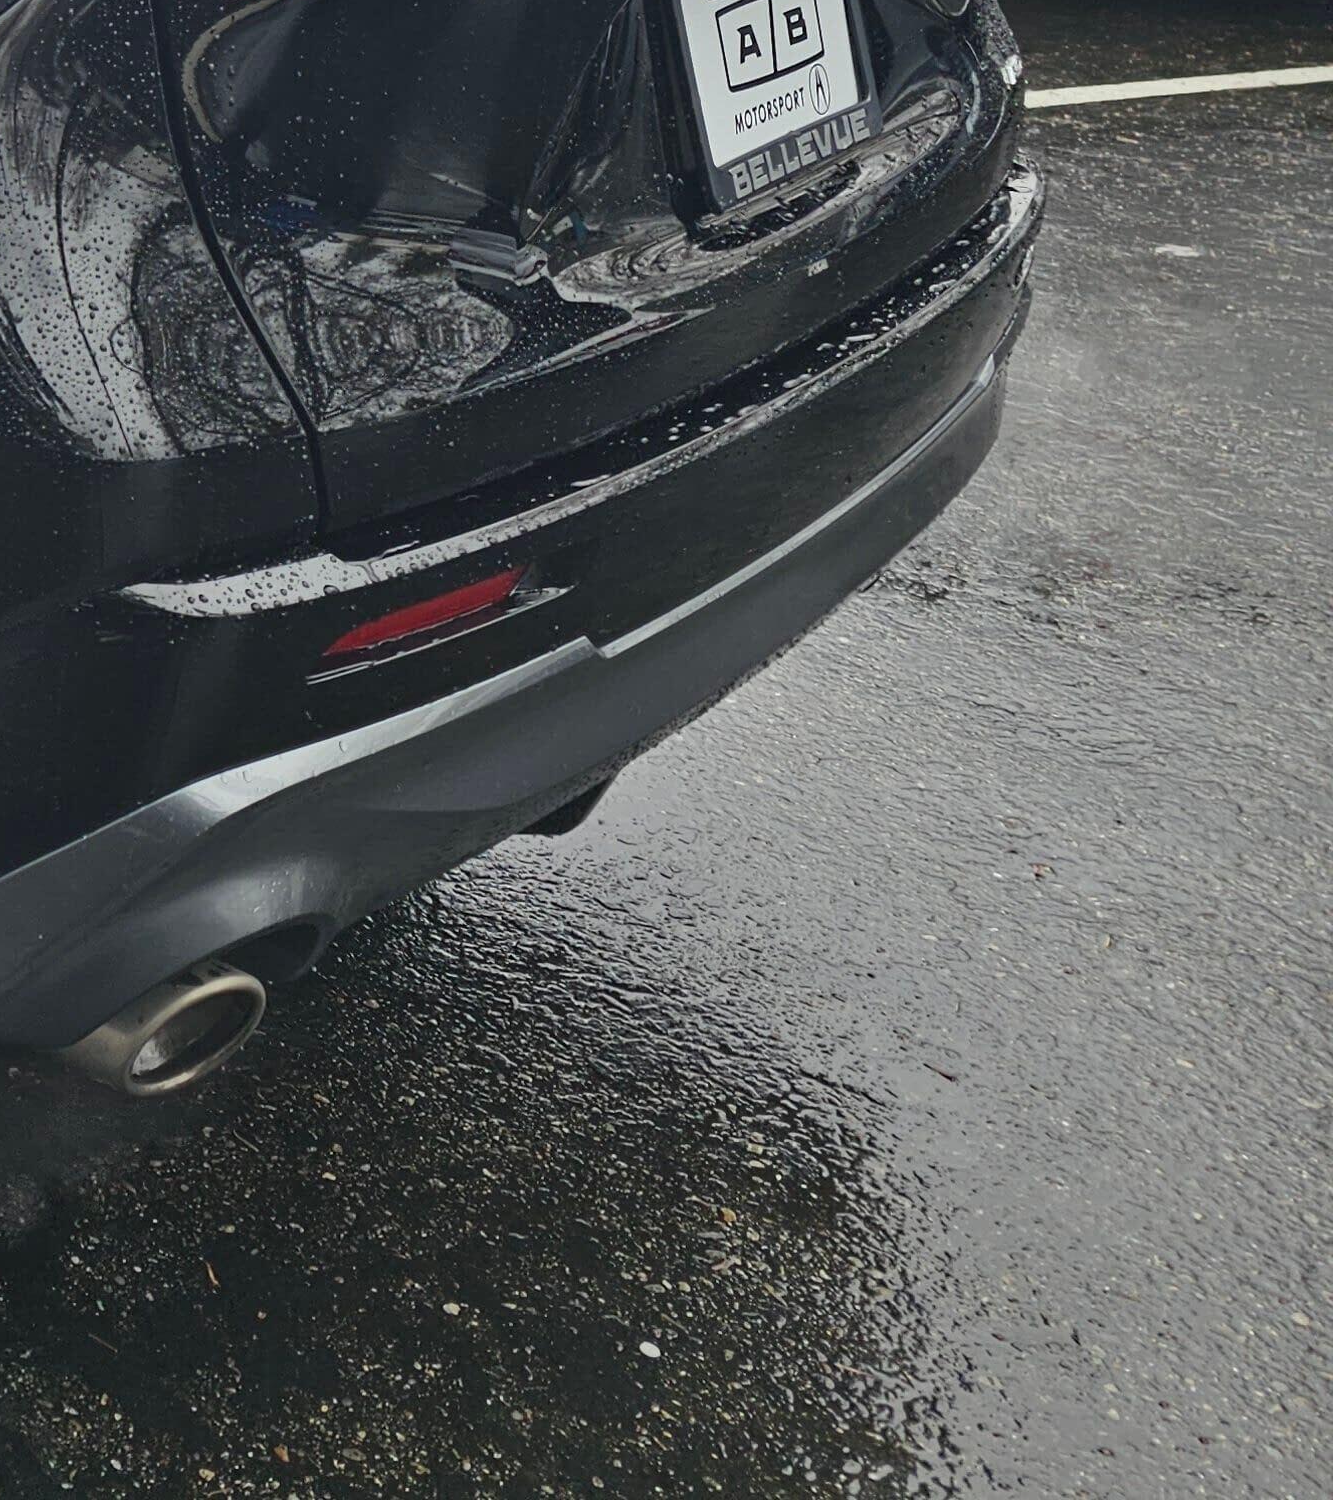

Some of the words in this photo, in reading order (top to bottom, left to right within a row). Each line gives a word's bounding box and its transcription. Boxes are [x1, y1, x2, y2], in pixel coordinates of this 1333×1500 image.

[736, 25, 762, 64] A
[783, 6, 808, 45] B
[734, 87, 806, 135] MOTORSPORT
[728, 109, 871, 200] BELLEVUE
